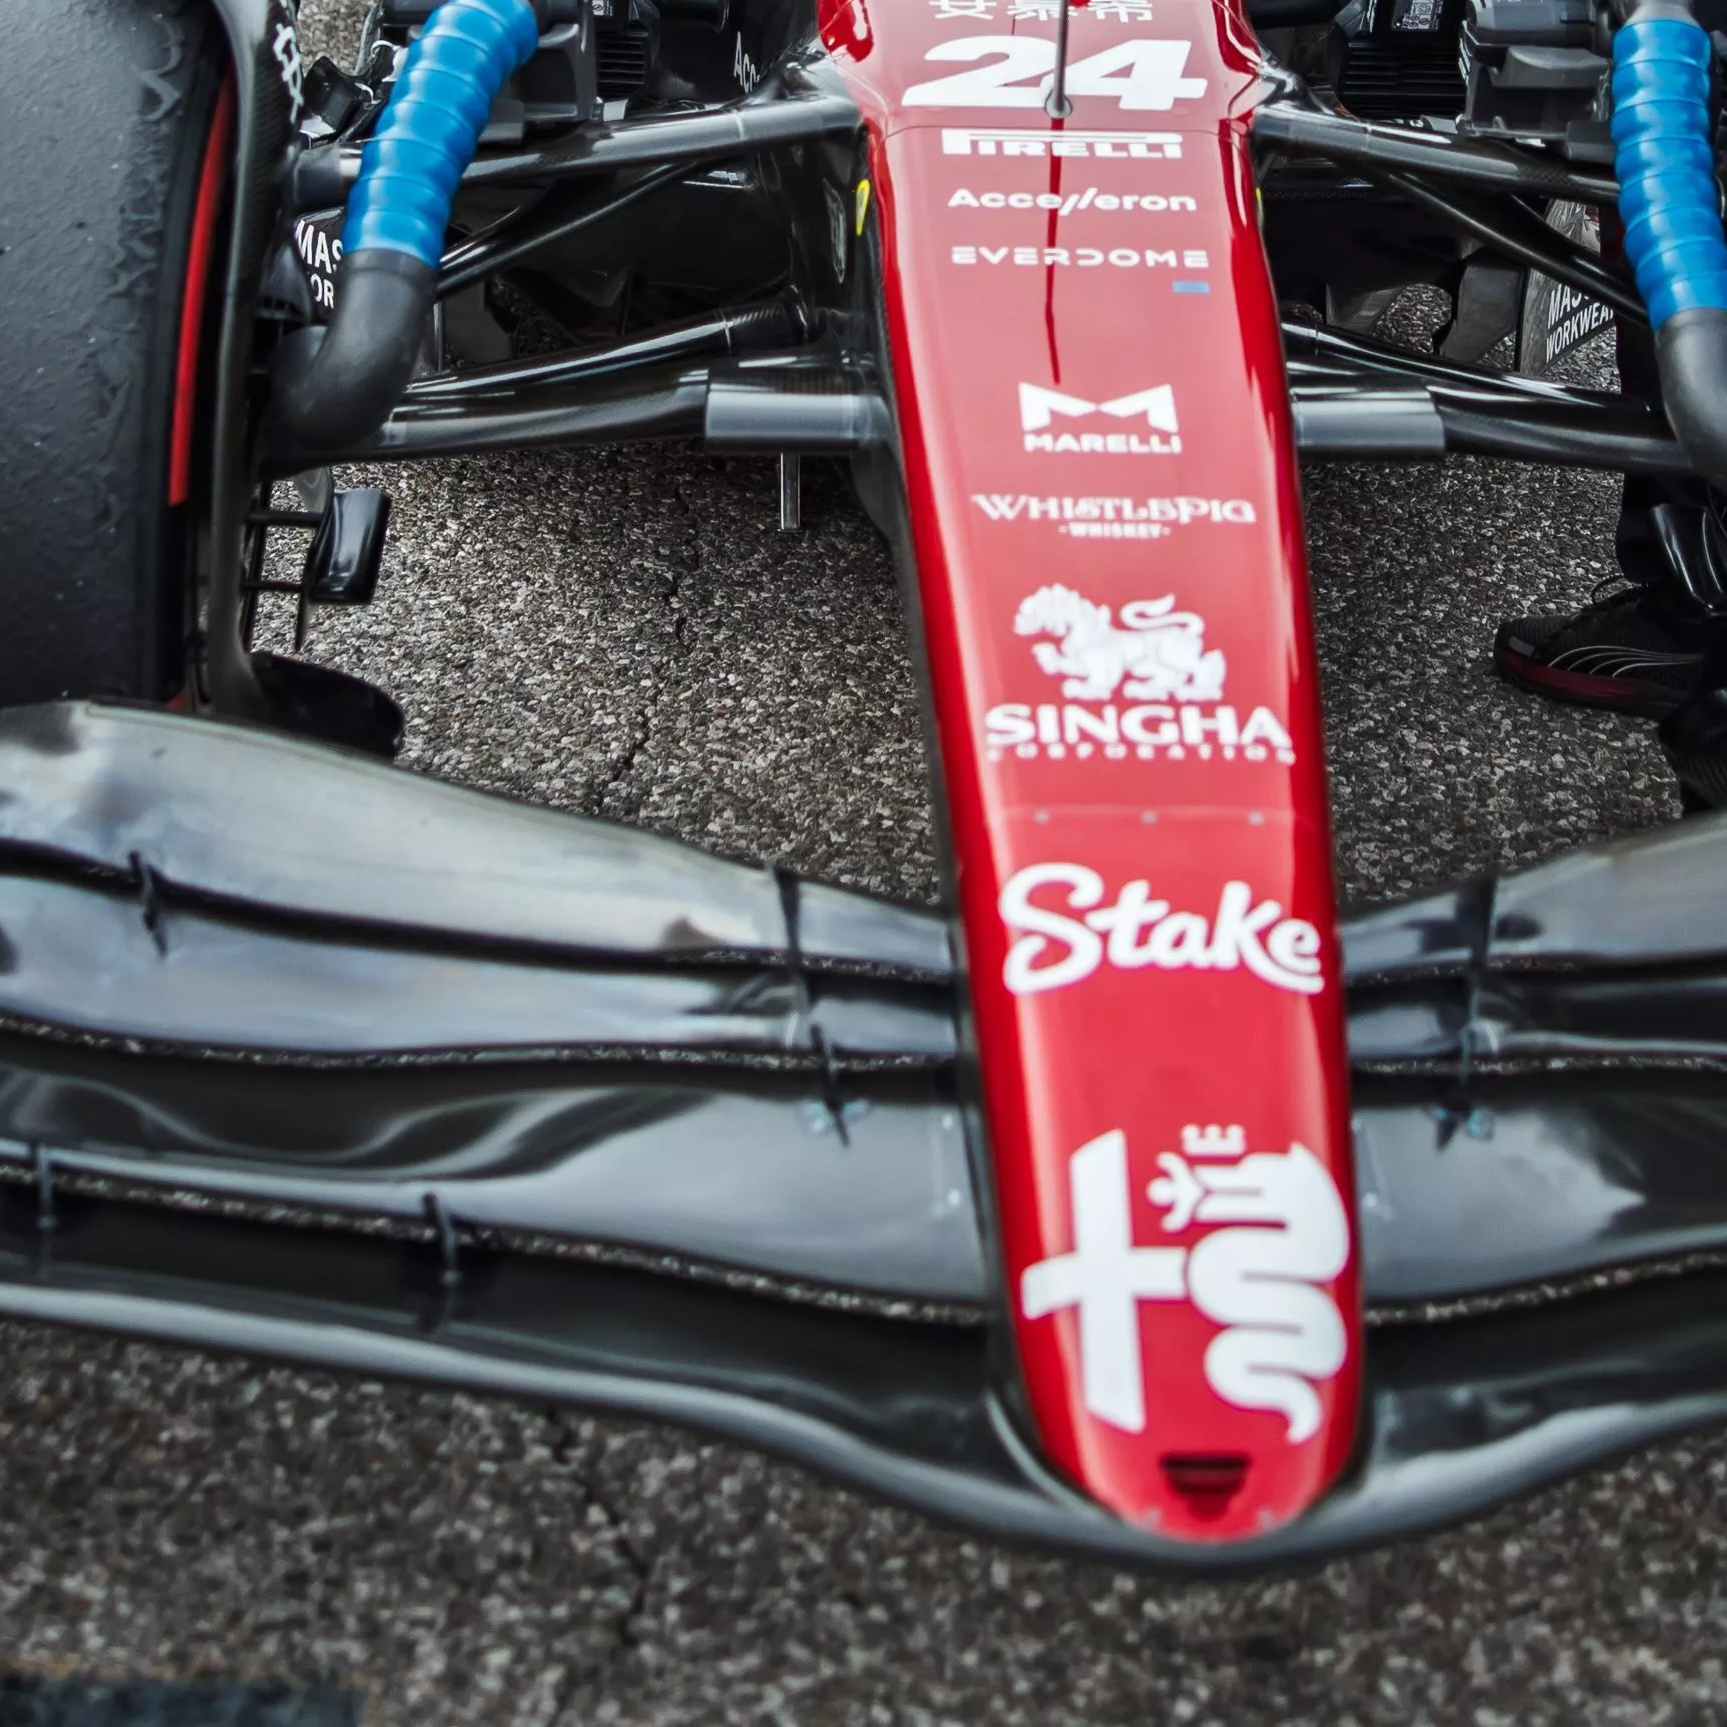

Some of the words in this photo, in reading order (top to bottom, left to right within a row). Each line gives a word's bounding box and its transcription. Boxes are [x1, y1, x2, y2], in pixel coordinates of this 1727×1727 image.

[901, 34, 1209, 112] 24
[941, 128, 1184, 159] PIRELLI
[948, 187, 1197, 217] Accelleron
[950, 246, 1210, 269] EVERDOME
[1023, 433, 1183, 455] MARELLI
[984, 702, 1293, 749] SINGHA
[997, 861, 1325, 995] Stake
